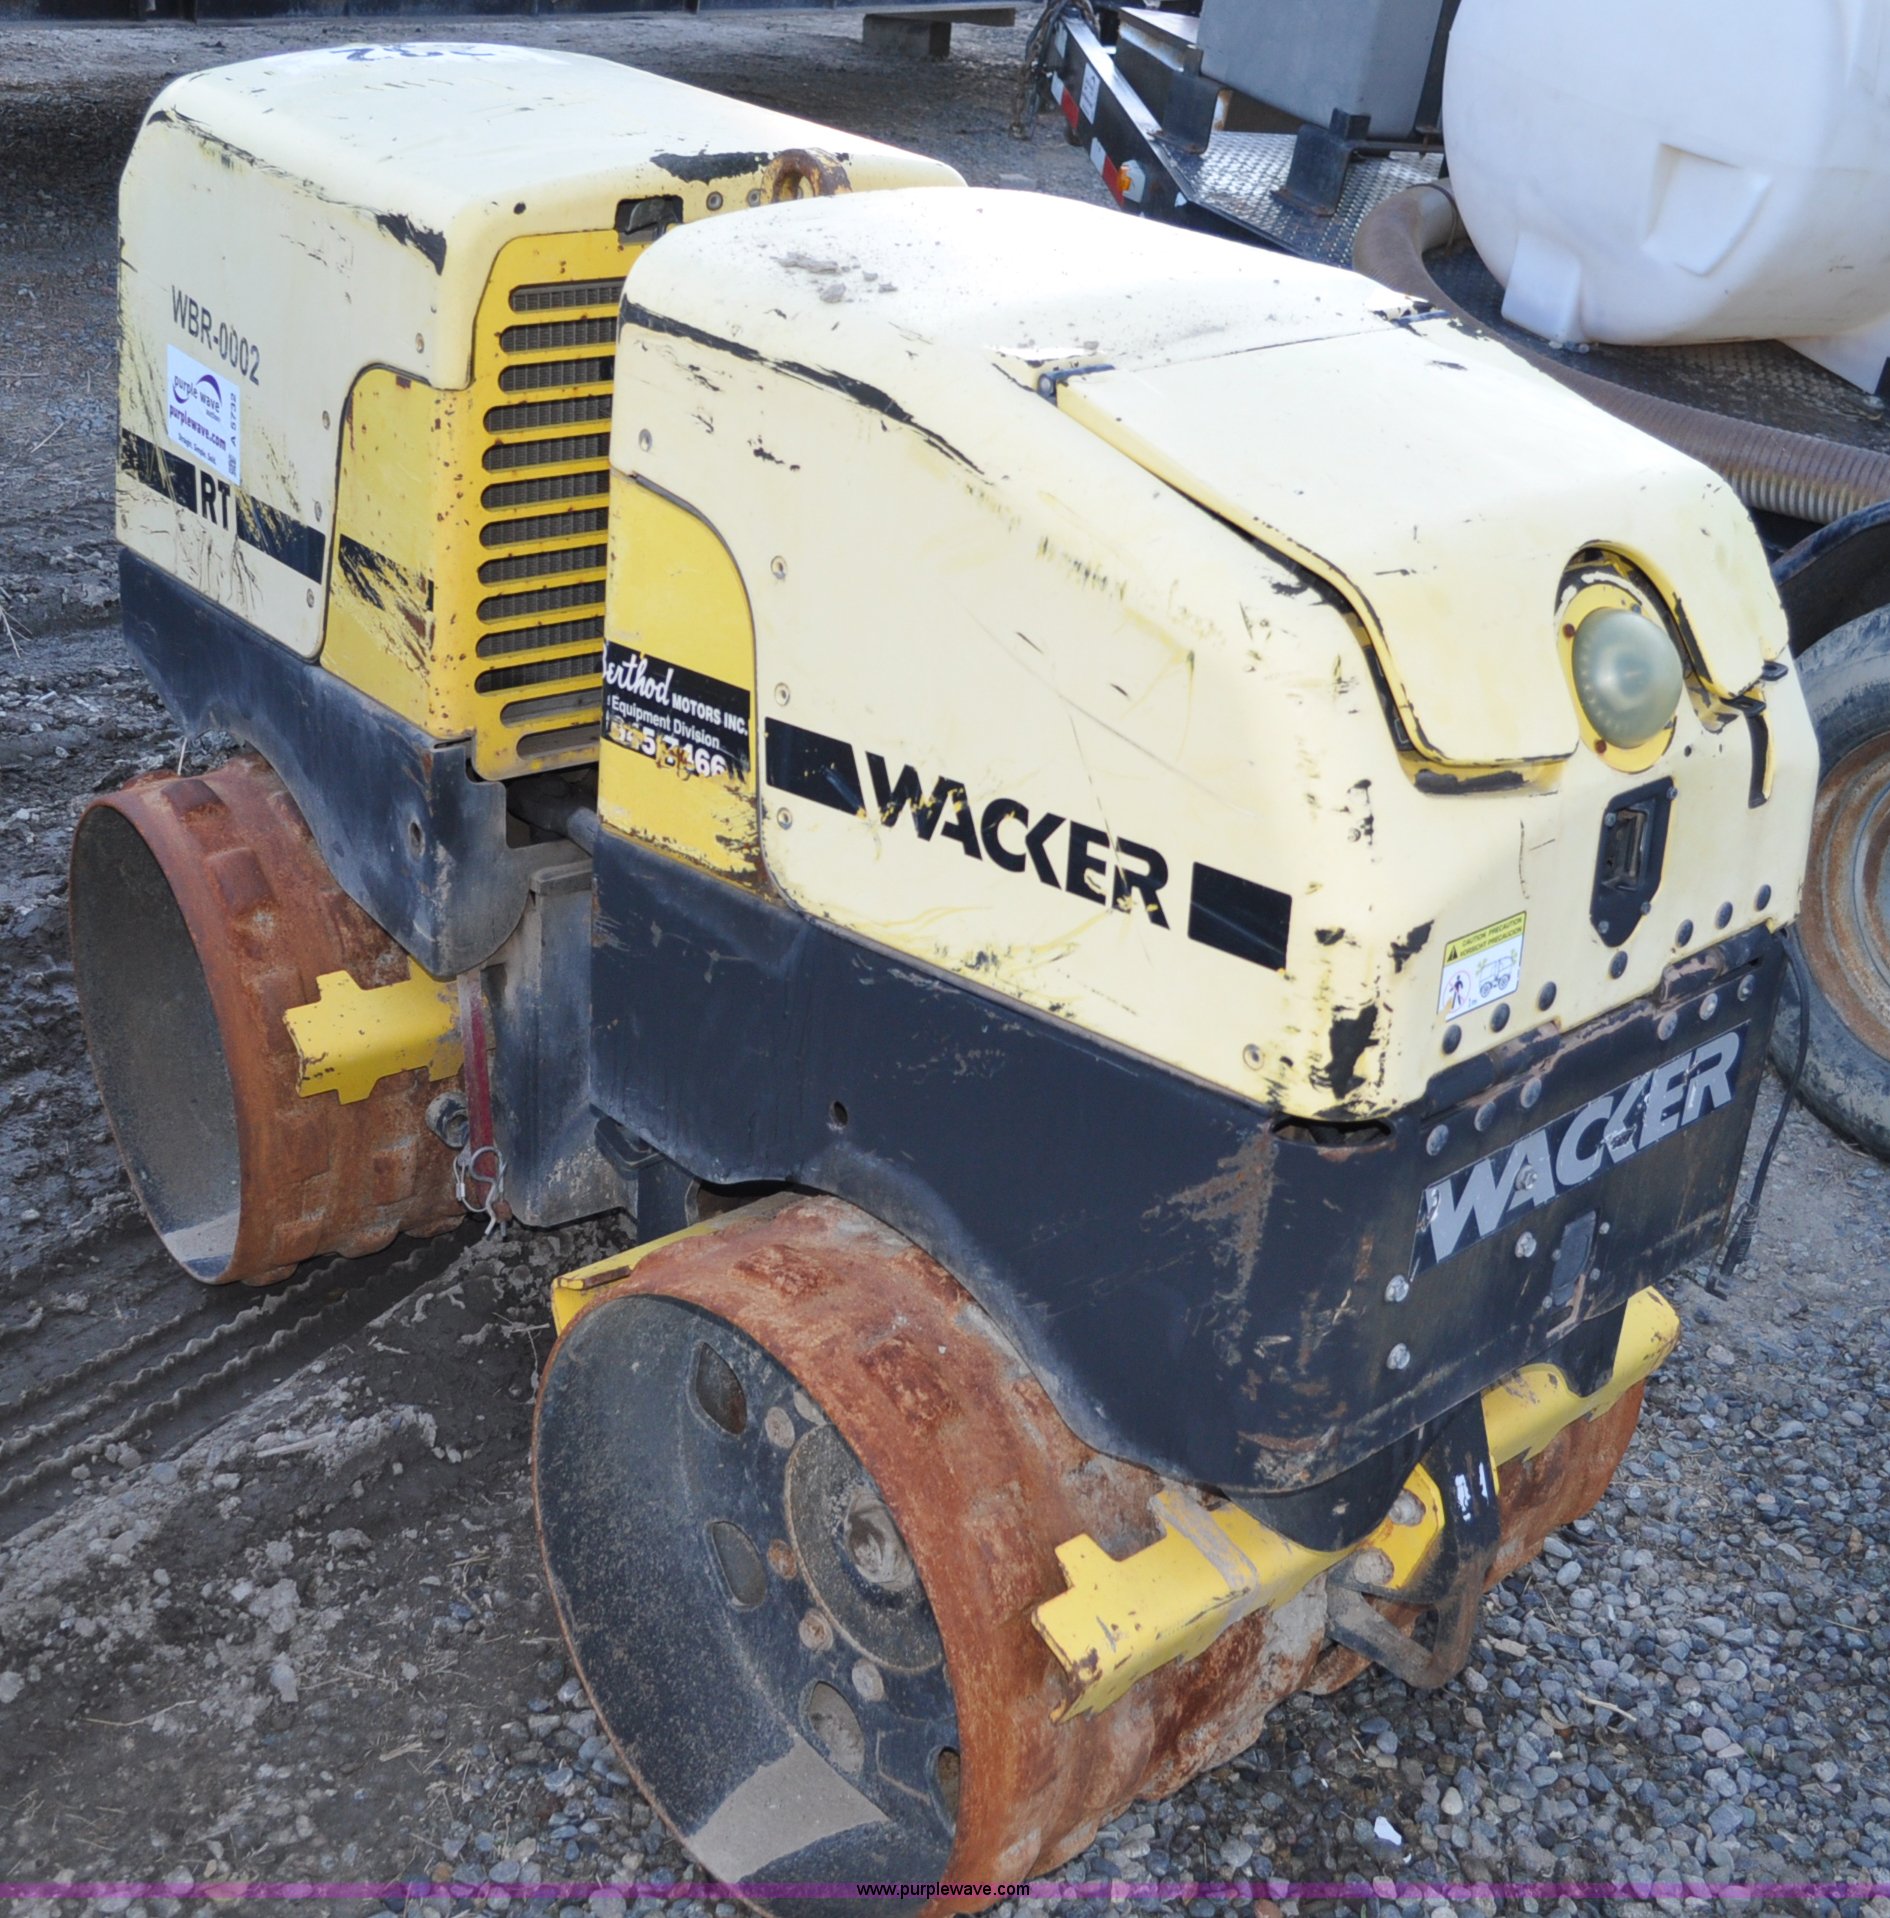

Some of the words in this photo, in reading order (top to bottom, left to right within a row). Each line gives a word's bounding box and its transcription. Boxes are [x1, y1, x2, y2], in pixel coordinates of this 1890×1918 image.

[171, 285, 260, 385] WBR-0002
[174, 375, 198, 399] purple
[200, 391, 220, 414] wave
[169, 404, 226, 451] purplewave.com
[200, 470, 231, 531] RT
[611, 694, 671, 731] Equipment
[673, 718, 721, 750] Division
[672, 692, 722, 726] MOTORS
[723, 711, 749, 736] INC.
[865, 751, 1170, 930] WACKER
[1425, 1031, 1740, 1263] WACKER
